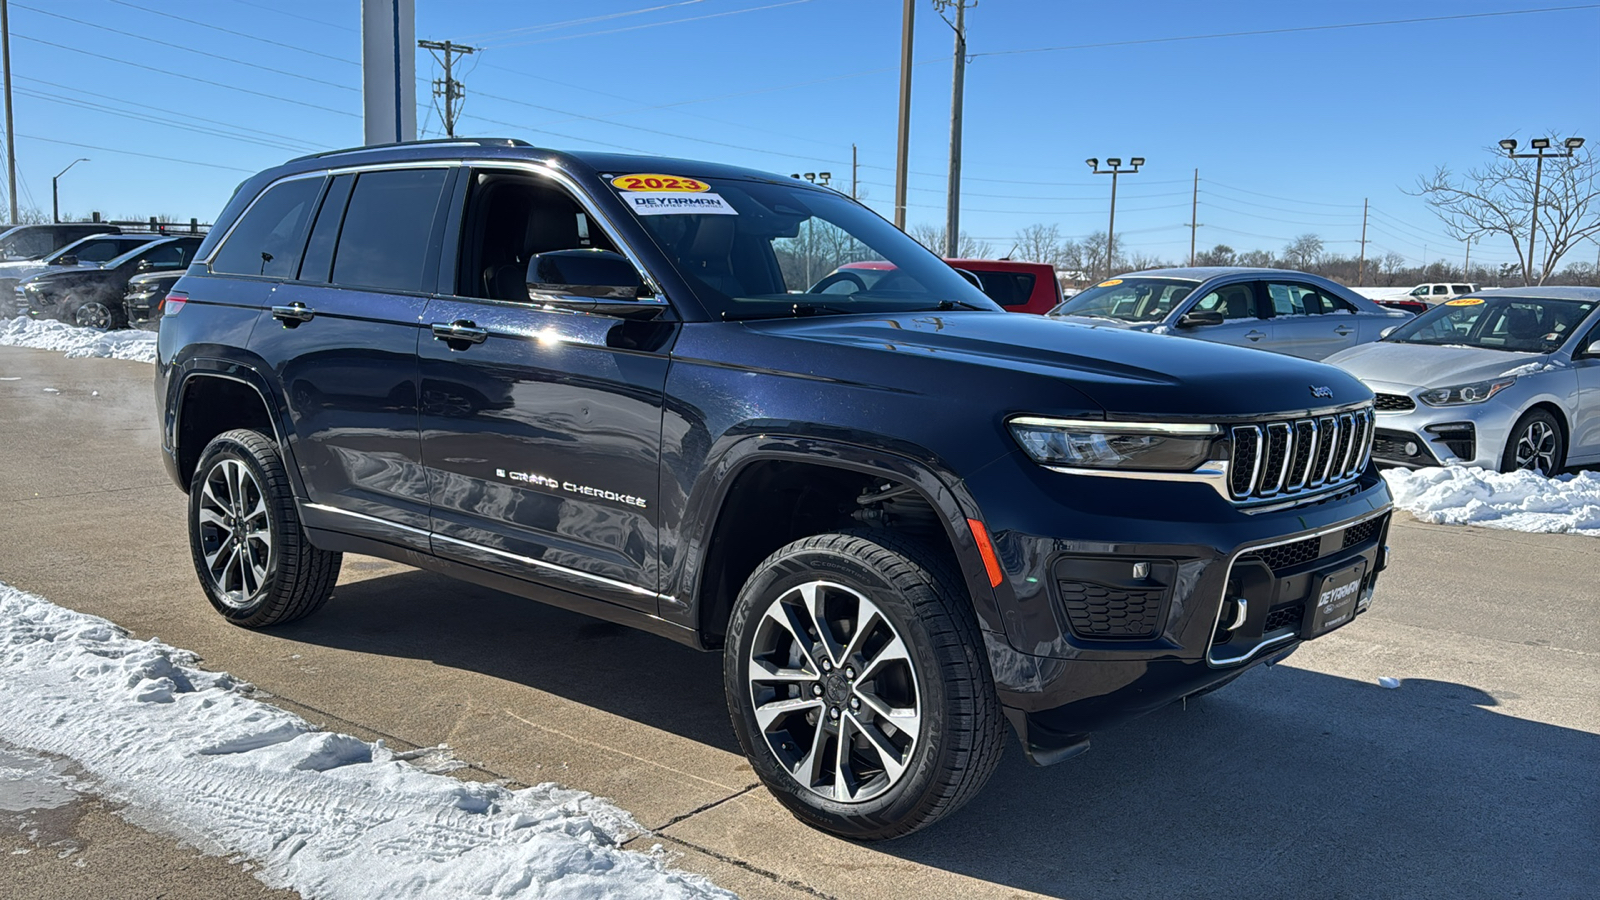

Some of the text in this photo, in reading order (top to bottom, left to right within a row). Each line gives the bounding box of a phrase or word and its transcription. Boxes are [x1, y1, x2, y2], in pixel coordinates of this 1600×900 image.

[625, 178, 701, 189] 2023
[509, 471, 646, 507] GRAND CHEROKEE
